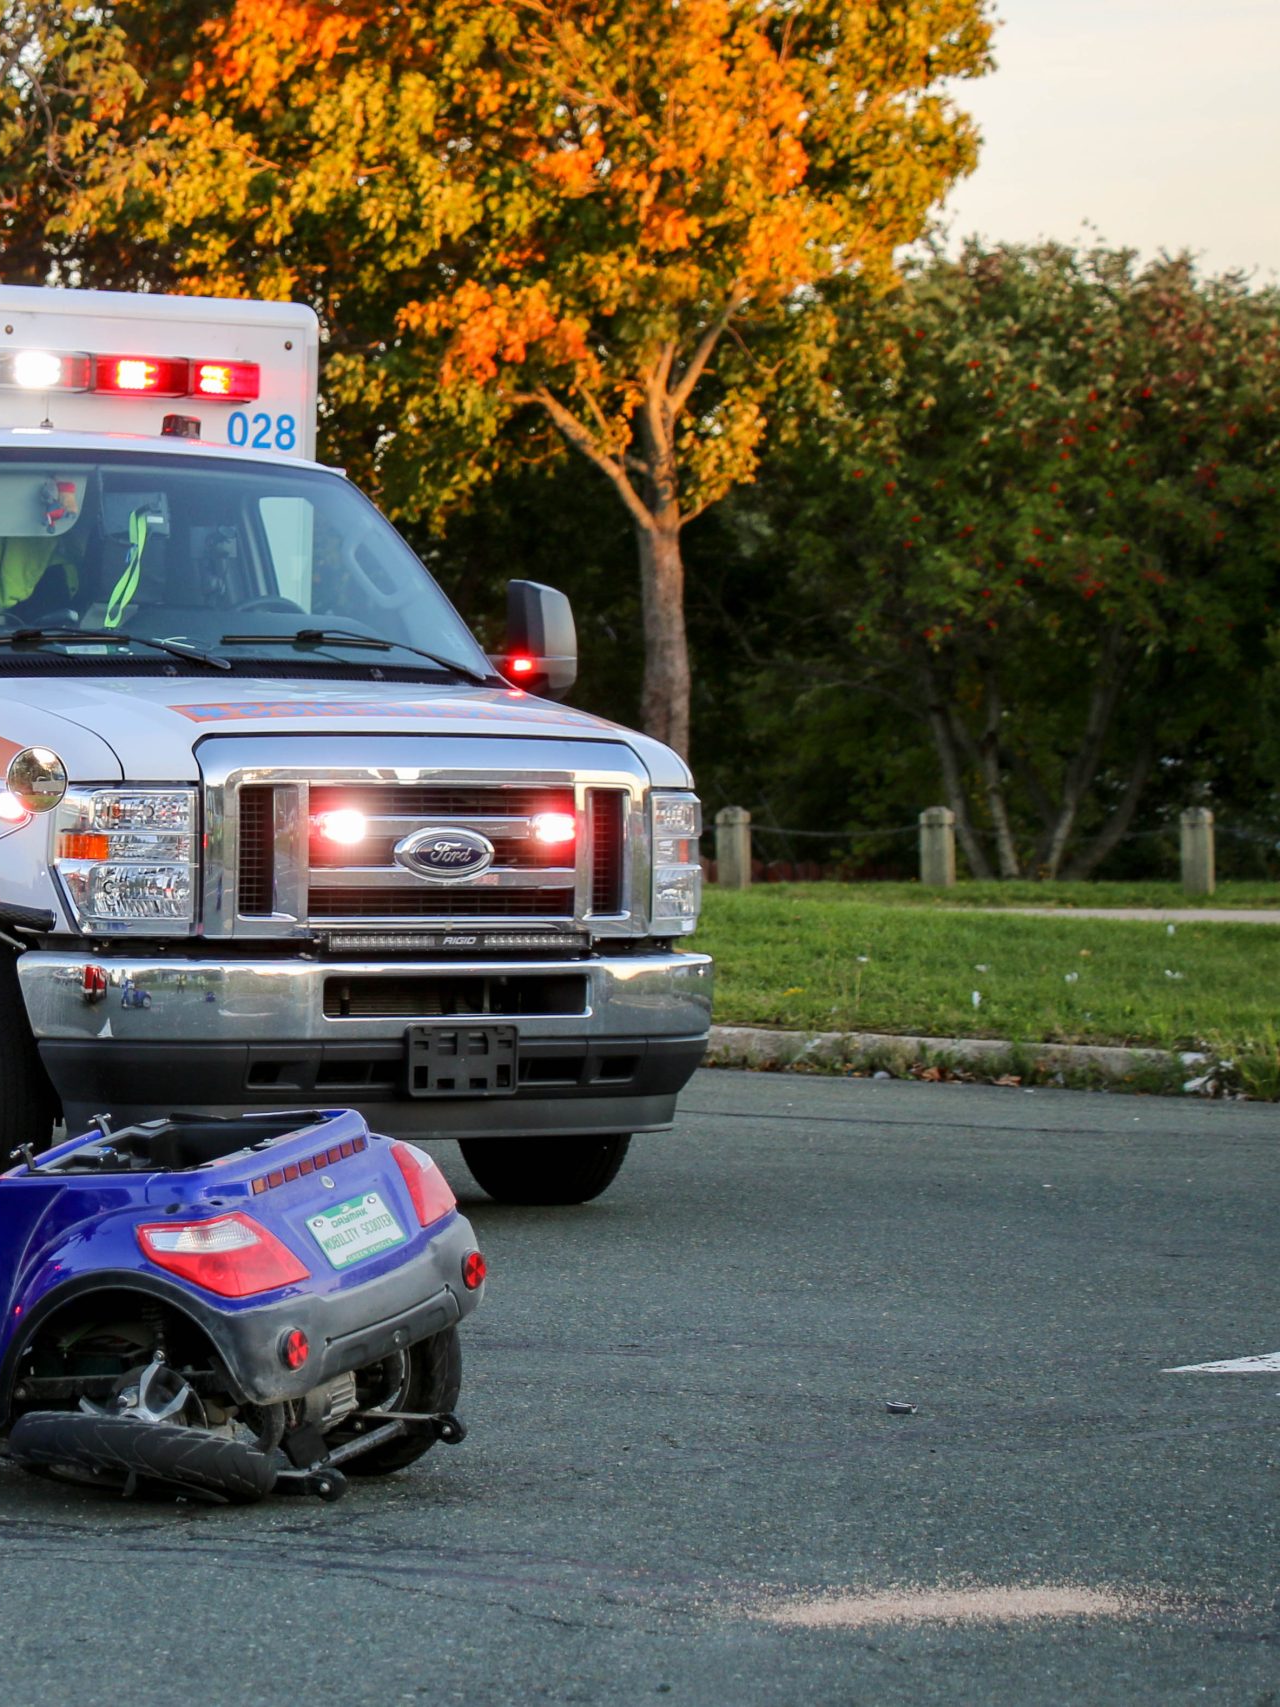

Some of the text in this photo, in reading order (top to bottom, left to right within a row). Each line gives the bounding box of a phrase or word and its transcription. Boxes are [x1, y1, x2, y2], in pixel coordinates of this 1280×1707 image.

[227, 411, 296, 450] 028
[430, 841, 472, 862] Ford
[442, 936, 477, 946] RIGID
[322, 1213, 393, 1252] MOBILITY SCOOTER
